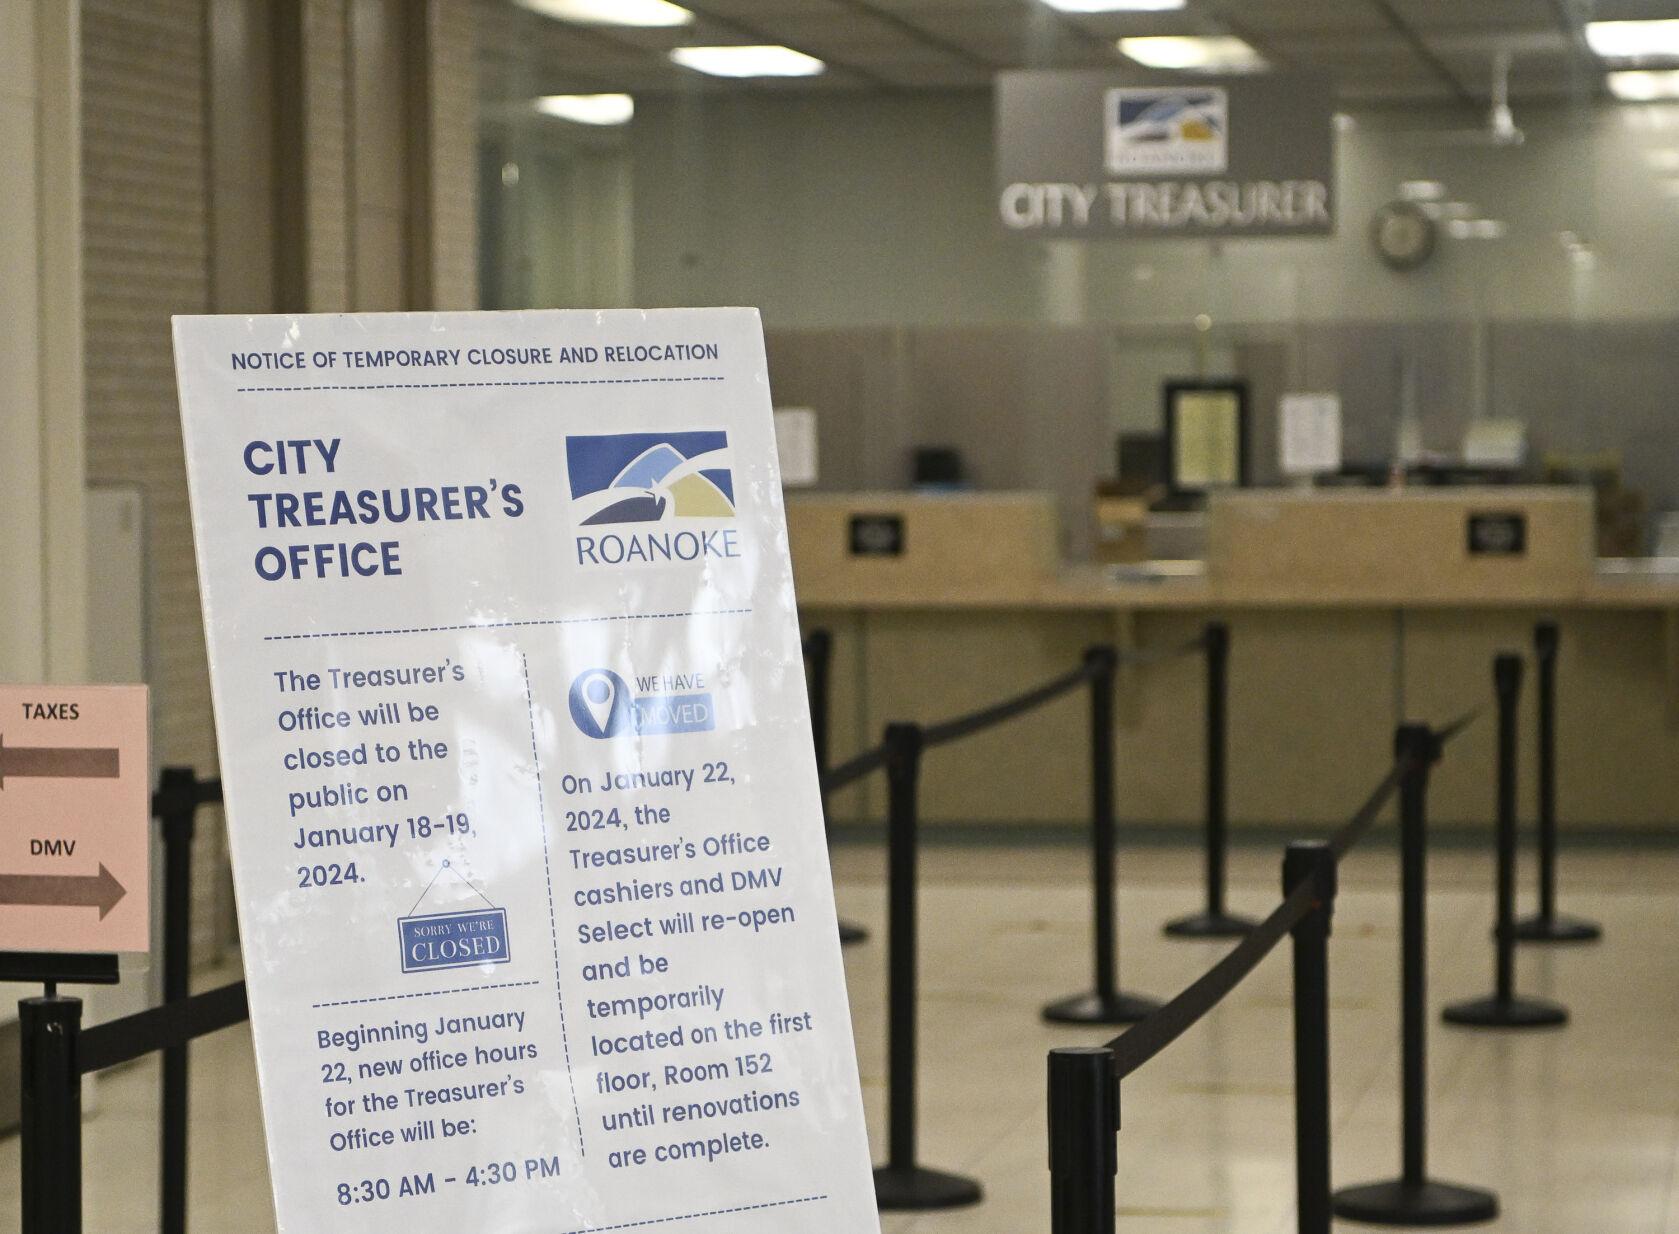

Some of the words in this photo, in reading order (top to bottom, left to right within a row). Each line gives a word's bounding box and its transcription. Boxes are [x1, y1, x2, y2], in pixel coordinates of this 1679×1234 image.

[1001, 182, 1097, 228] CITY
[1105, 180, 1328, 226] TREASURER
[232, 352, 306, 370] NOTICE
[313, 352, 336, 368] OF
[343, 350, 460, 368] TEMPORARY
[468, 348, 552, 365] CLOSURE
[560, 347, 598, 363] AND
[605, 344, 718, 362] RELOCATION
[244, 439, 340, 475] CITY
[248, 479, 523, 528] TREASURER'S
[255, 541, 402, 581] OFFICE
[577, 531, 741, 565] ROANOKE
[274, 670, 320, 692] The
[328, 659, 464, 688] Treasurer's
[636, 676, 657, 692] WE
[663, 673, 705, 691] HAVE
[22, 703, 79, 720] TAXES
[279, 707, 350, 731] Office
[358, 703, 400, 725] will
[408, 702, 439, 722] be
[641, 703, 708, 725] MOVED
[284, 743, 367, 770] closed
[375, 744, 400, 762] to
[408, 739, 448, 760] the
[562, 775, 592, 794] On
[601, 767, 694, 792] January
[703, 762, 735, 784] 22,
[289, 783, 368, 817] public
[377, 784, 408, 802] on
[566, 808, 627, 831] 2024,
[635, 805, 670, 825] the
[31, 839, 75, 856] DMV
[294, 822, 400, 849] January
[569, 837, 696, 869] Treasurer's
[703, 833, 770, 856] Office
[298, 862, 365, 888] 2024.
[575, 879, 673, 906] cashiers
[680, 872, 724, 896] and
[731, 868, 782, 891] DMV
[413, 924, 453, 938] SORRY
[578, 918, 653, 944] Select
[659, 912, 694, 935] will
[702, 906, 795, 932] re-open
[411, 935, 501, 962] CLOSED
[583, 956, 630, 981] and
[639, 955, 668, 974] be
[588, 985, 725, 1019] temporarily
[318, 1020, 428, 1051] Beginning
[434, 1011, 525, 1036] January
[592, 1026, 683, 1056] located
[691, 1027, 717, 1044] on
[724, 1019, 762, 1040] the
[770, 1012, 812, 1034] first
[322, 1063, 352, 1084] 22,
[359, 1060, 402, 1078] new
[410, 1050, 467, 1072] office
[476, 1042, 537, 1064] hours
[597, 1072, 656, 1093] floor,
[665, 1063, 728, 1085] Room
[735, 1053, 772, 1076] 152
[325, 1098, 355, 1117] for
[363, 1093, 398, 1112] the
[404, 1074, 524, 1107] Treasurer's
[602, 1105, 654, 1131] until
[663, 1091, 799, 1123] renovations
[330, 1128, 394, 1151] Office
[400, 1120, 434, 1142] will
[442, 1119, 476, 1137] be:
[609, 1149, 646, 1168] are
[655, 1132, 769, 1162] complete.
[337, 1179, 390, 1205] 8:30
[399, 1173, 435, 1197] AM
[466, 1162, 516, 1186] 4:30
[525, 1156, 560, 1179] PM
